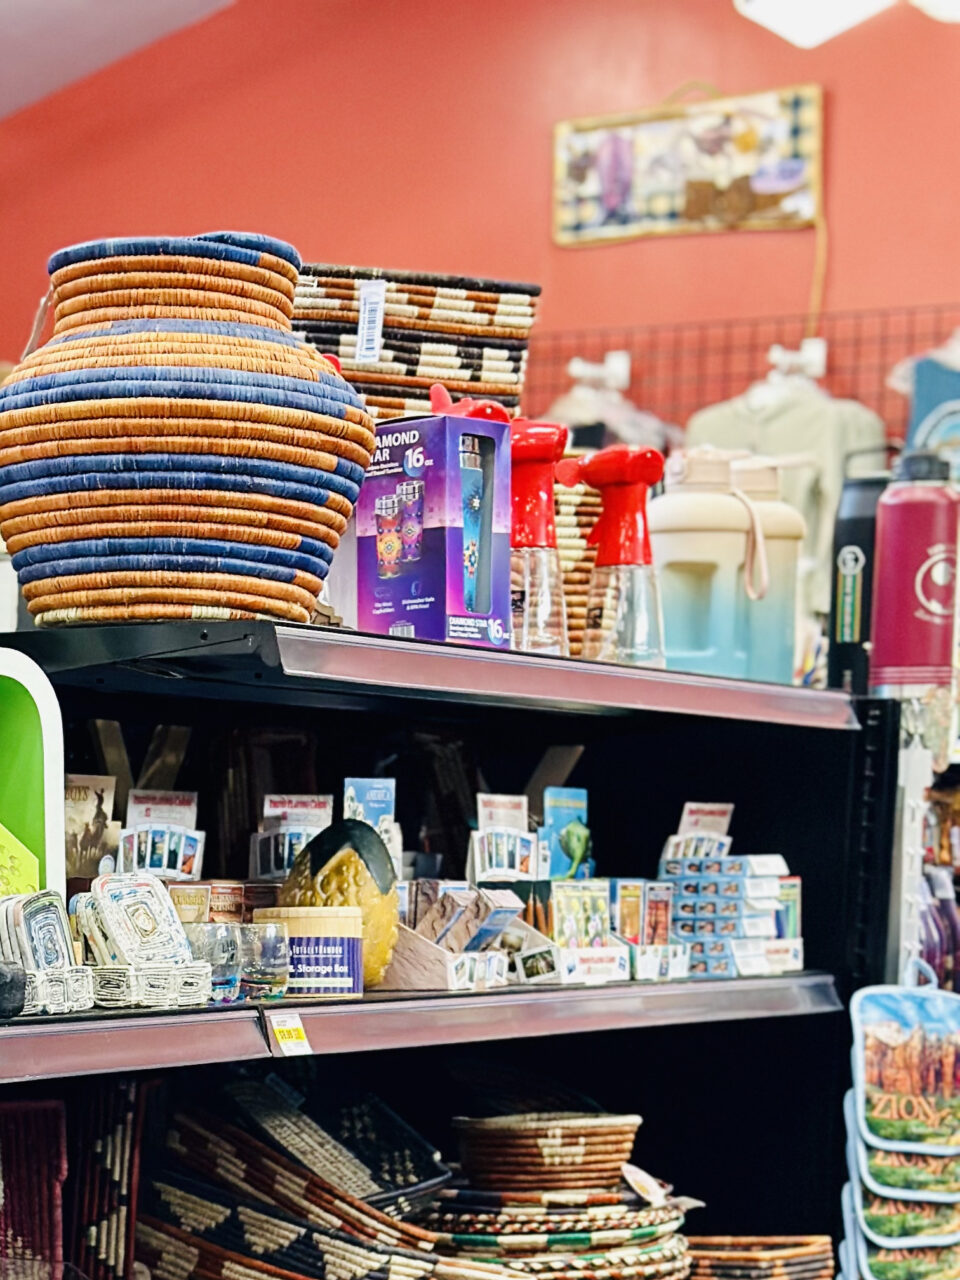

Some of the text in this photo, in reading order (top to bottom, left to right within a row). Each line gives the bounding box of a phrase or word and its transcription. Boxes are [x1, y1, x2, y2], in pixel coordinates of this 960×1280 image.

[375, 430, 420, 449] AMOND
[370, 448, 390, 463] AR
[405, 446, 425, 469] 16
[487, 618, 503, 639] 16
[297, 963, 333, 975] Storage
[334, 963, 349, 973] Box
[871, 1093, 937, 1122] ZION
